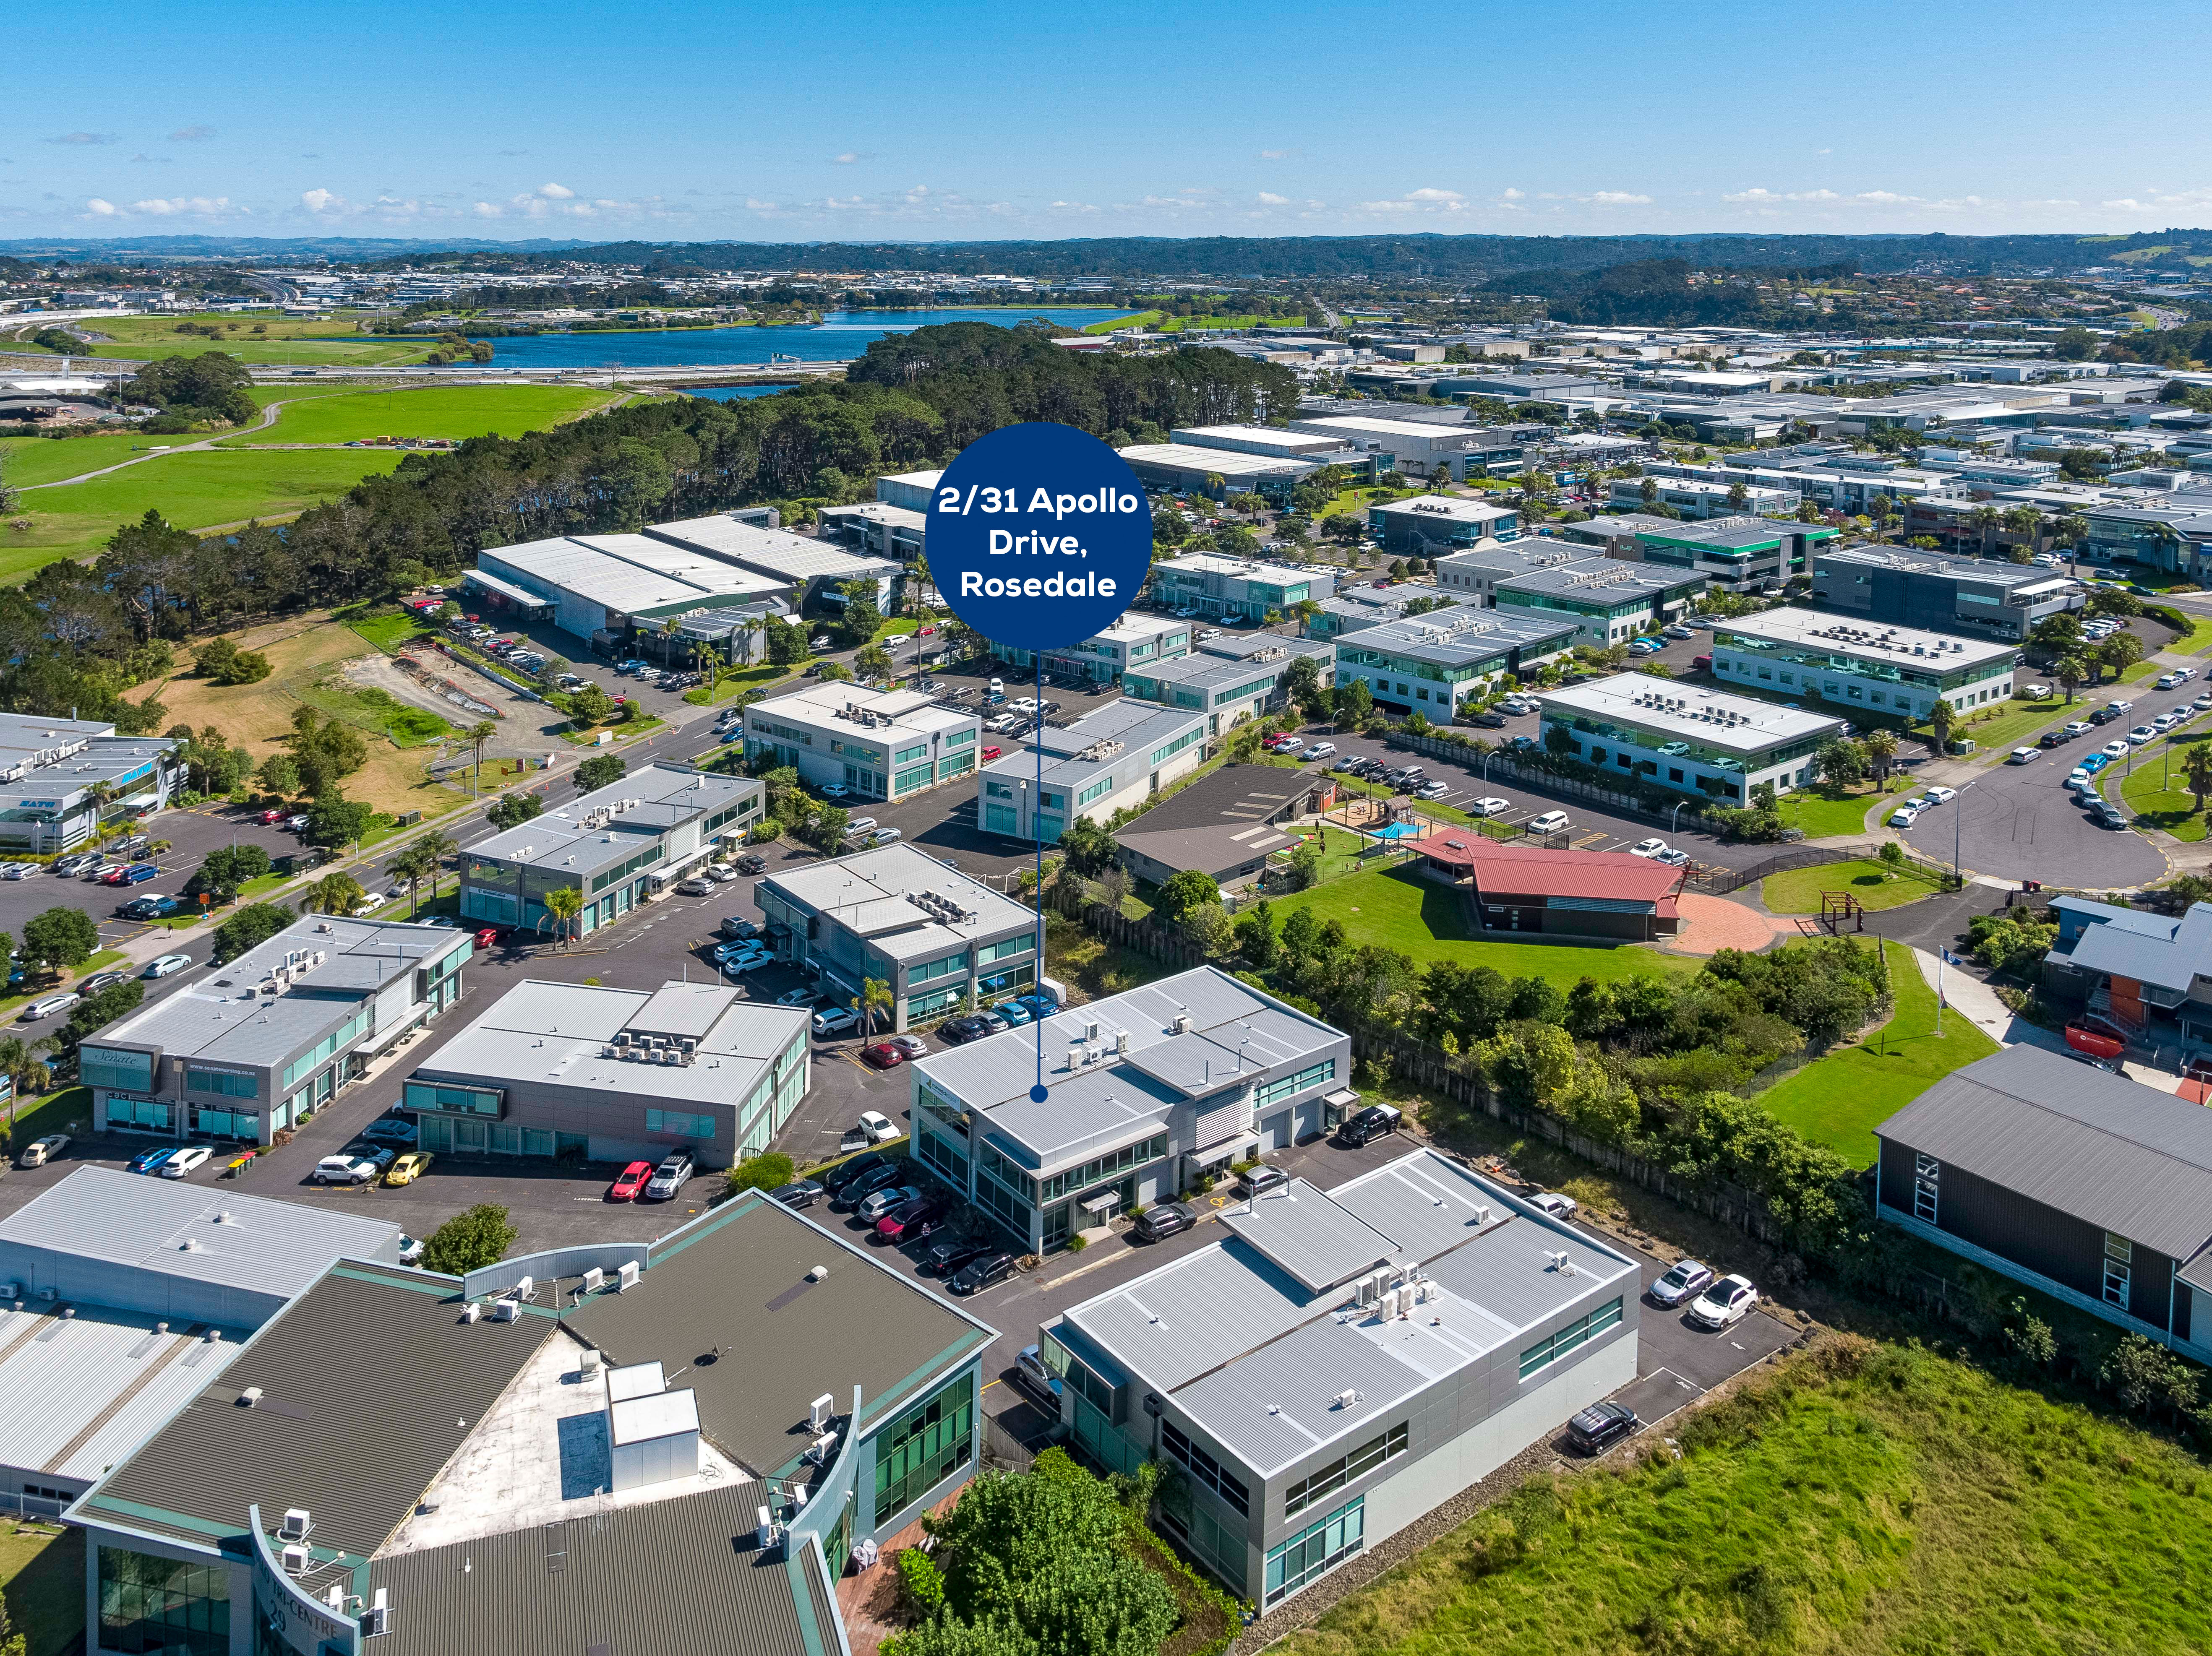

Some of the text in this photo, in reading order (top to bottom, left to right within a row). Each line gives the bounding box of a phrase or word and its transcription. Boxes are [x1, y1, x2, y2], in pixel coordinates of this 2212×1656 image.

[121, 762, 152, 784] SATO
[95, 1050, 136, 1065] Senate
[270, 1599, 286, 1632] 29
[273, 1580, 337, 1637] TRI-CENTRE
